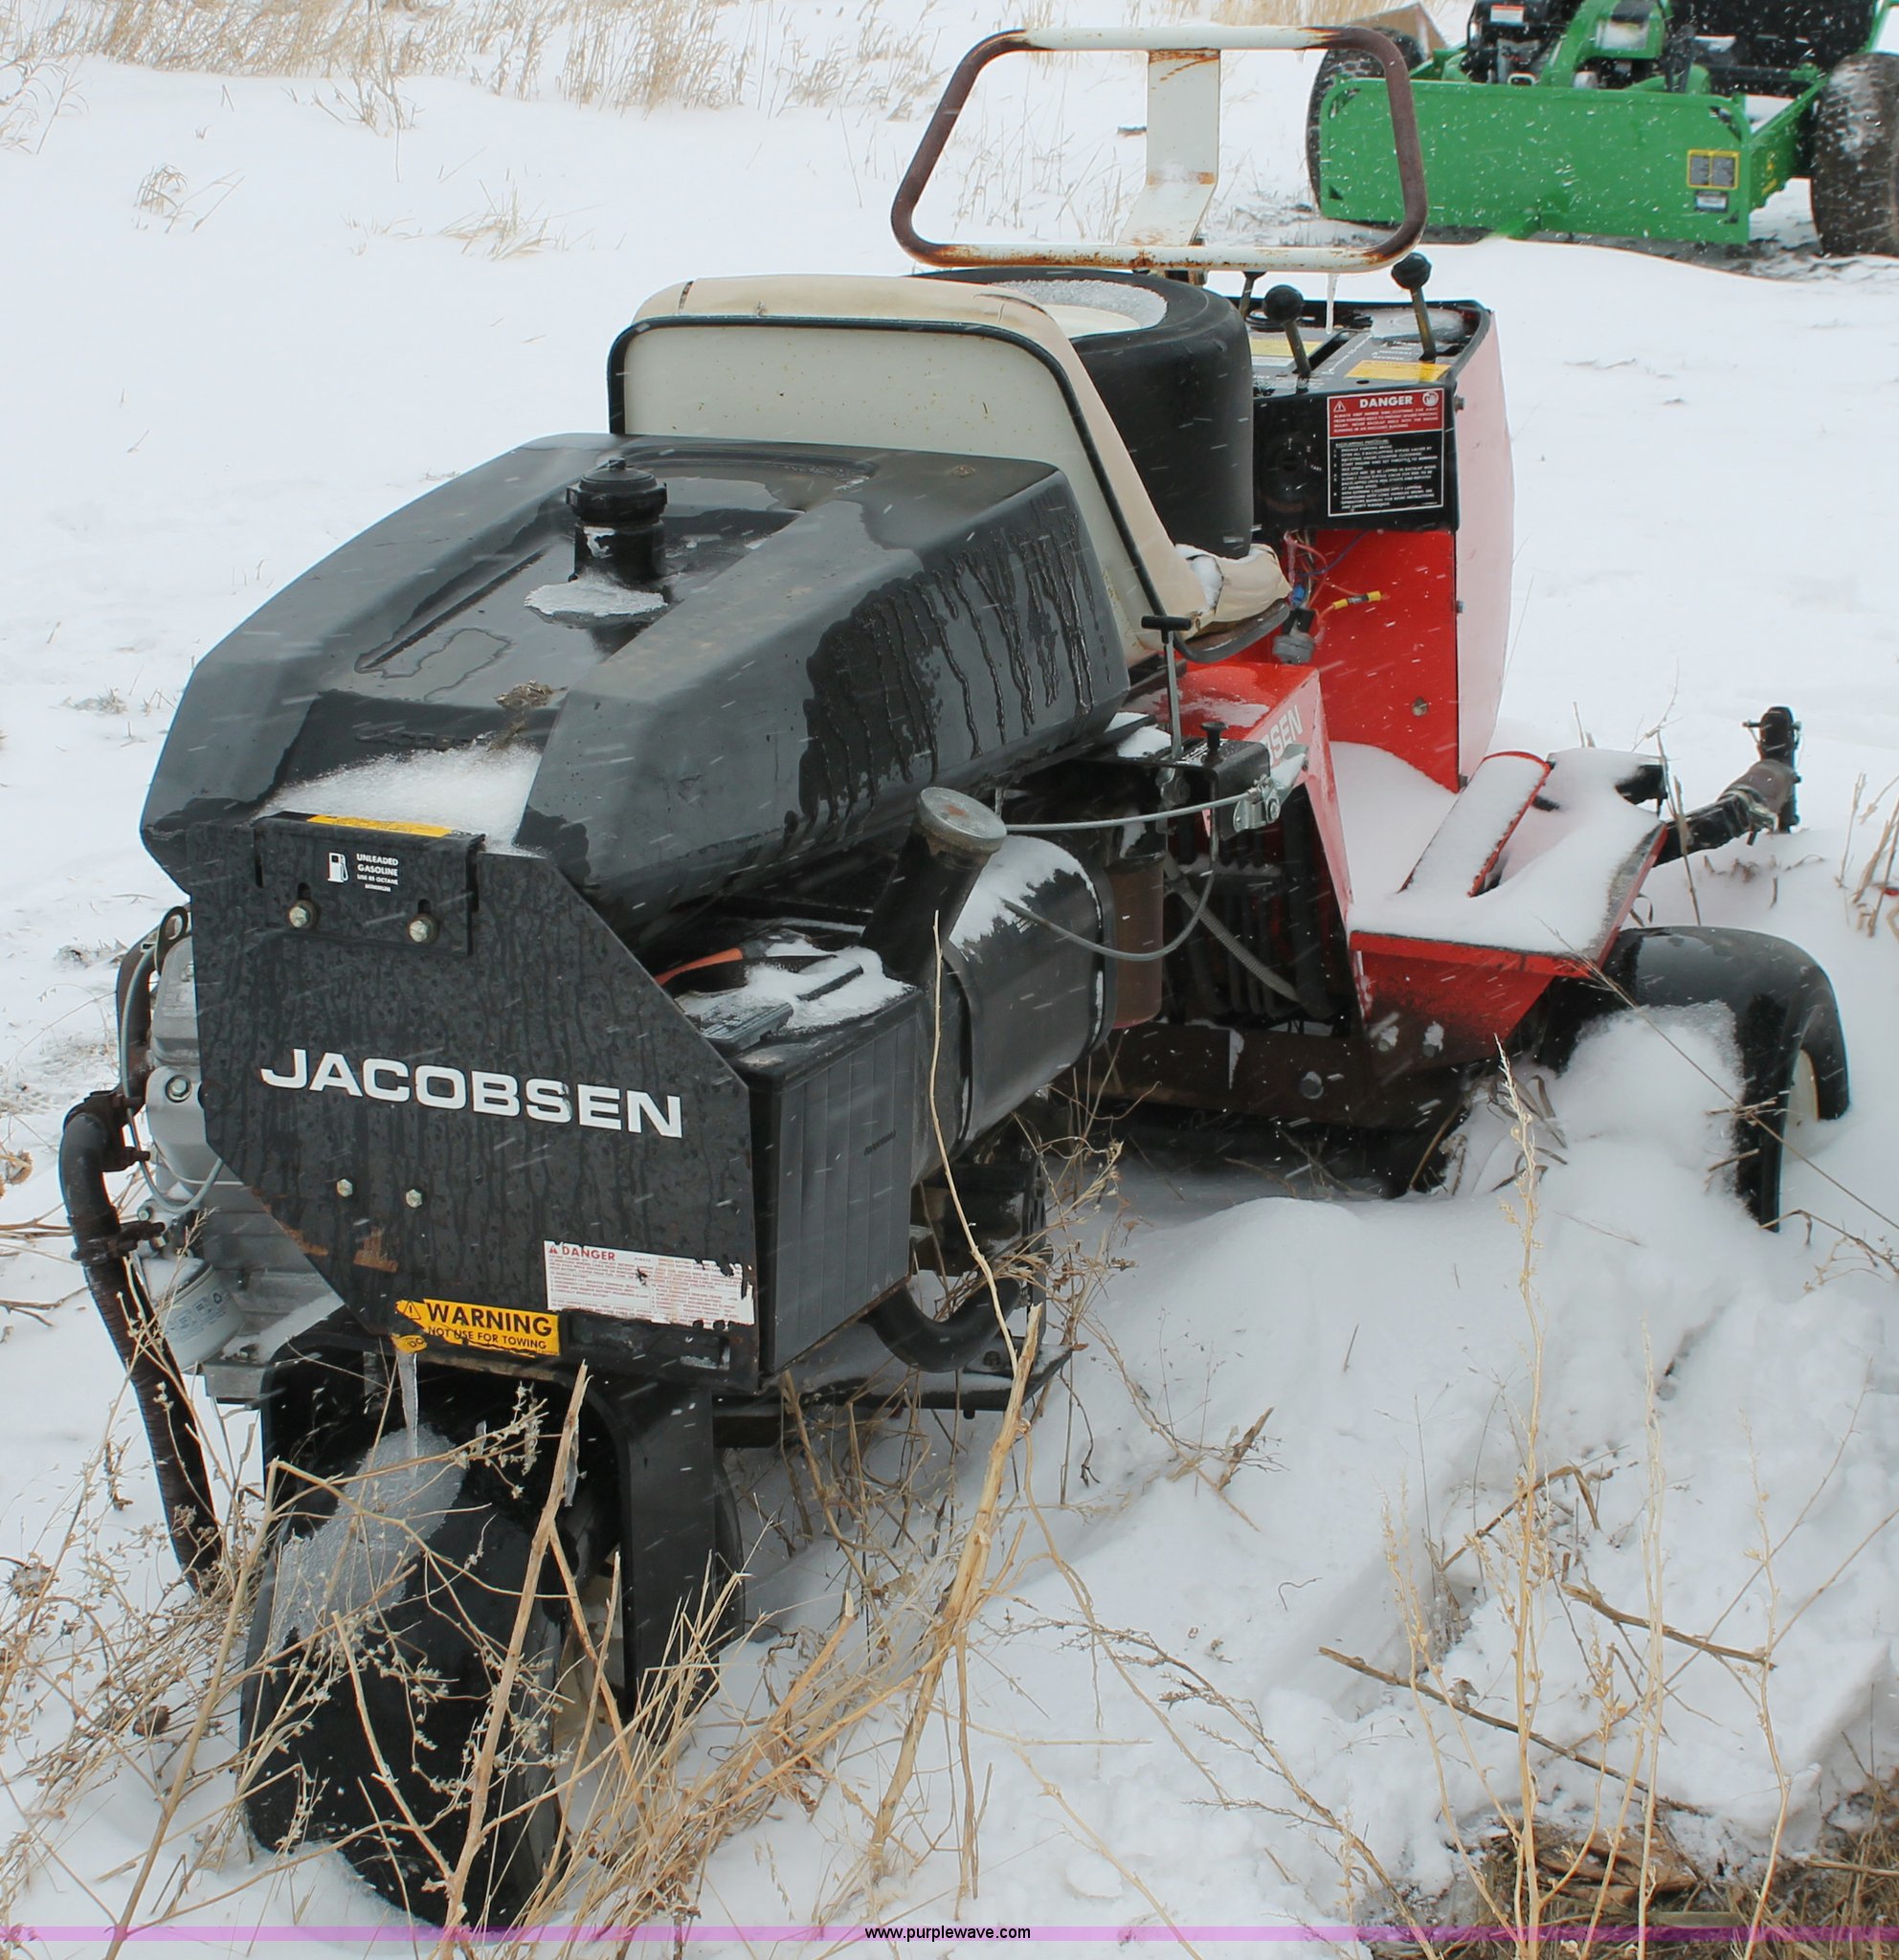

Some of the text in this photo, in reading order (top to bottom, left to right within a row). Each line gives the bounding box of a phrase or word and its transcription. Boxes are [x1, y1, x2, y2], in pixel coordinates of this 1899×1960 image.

[1359, 395, 1413, 408] DANGER
[356, 853, 399, 866] UNLEADED
[357, 863, 398, 877] GASOLINE
[375, 877, 399, 885] OCTANE
[260, 1048, 682, 1139] JACOBSEN
[562, 1245, 616, 1261] DANGER
[425, 1303, 552, 1337] WARNING
[407, 1337, 424, 1348] DO
[428, 1325, 450, 1338] NOT
[478, 1332, 499, 1343] FOR
[503, 1335, 547, 1349] TOWING
